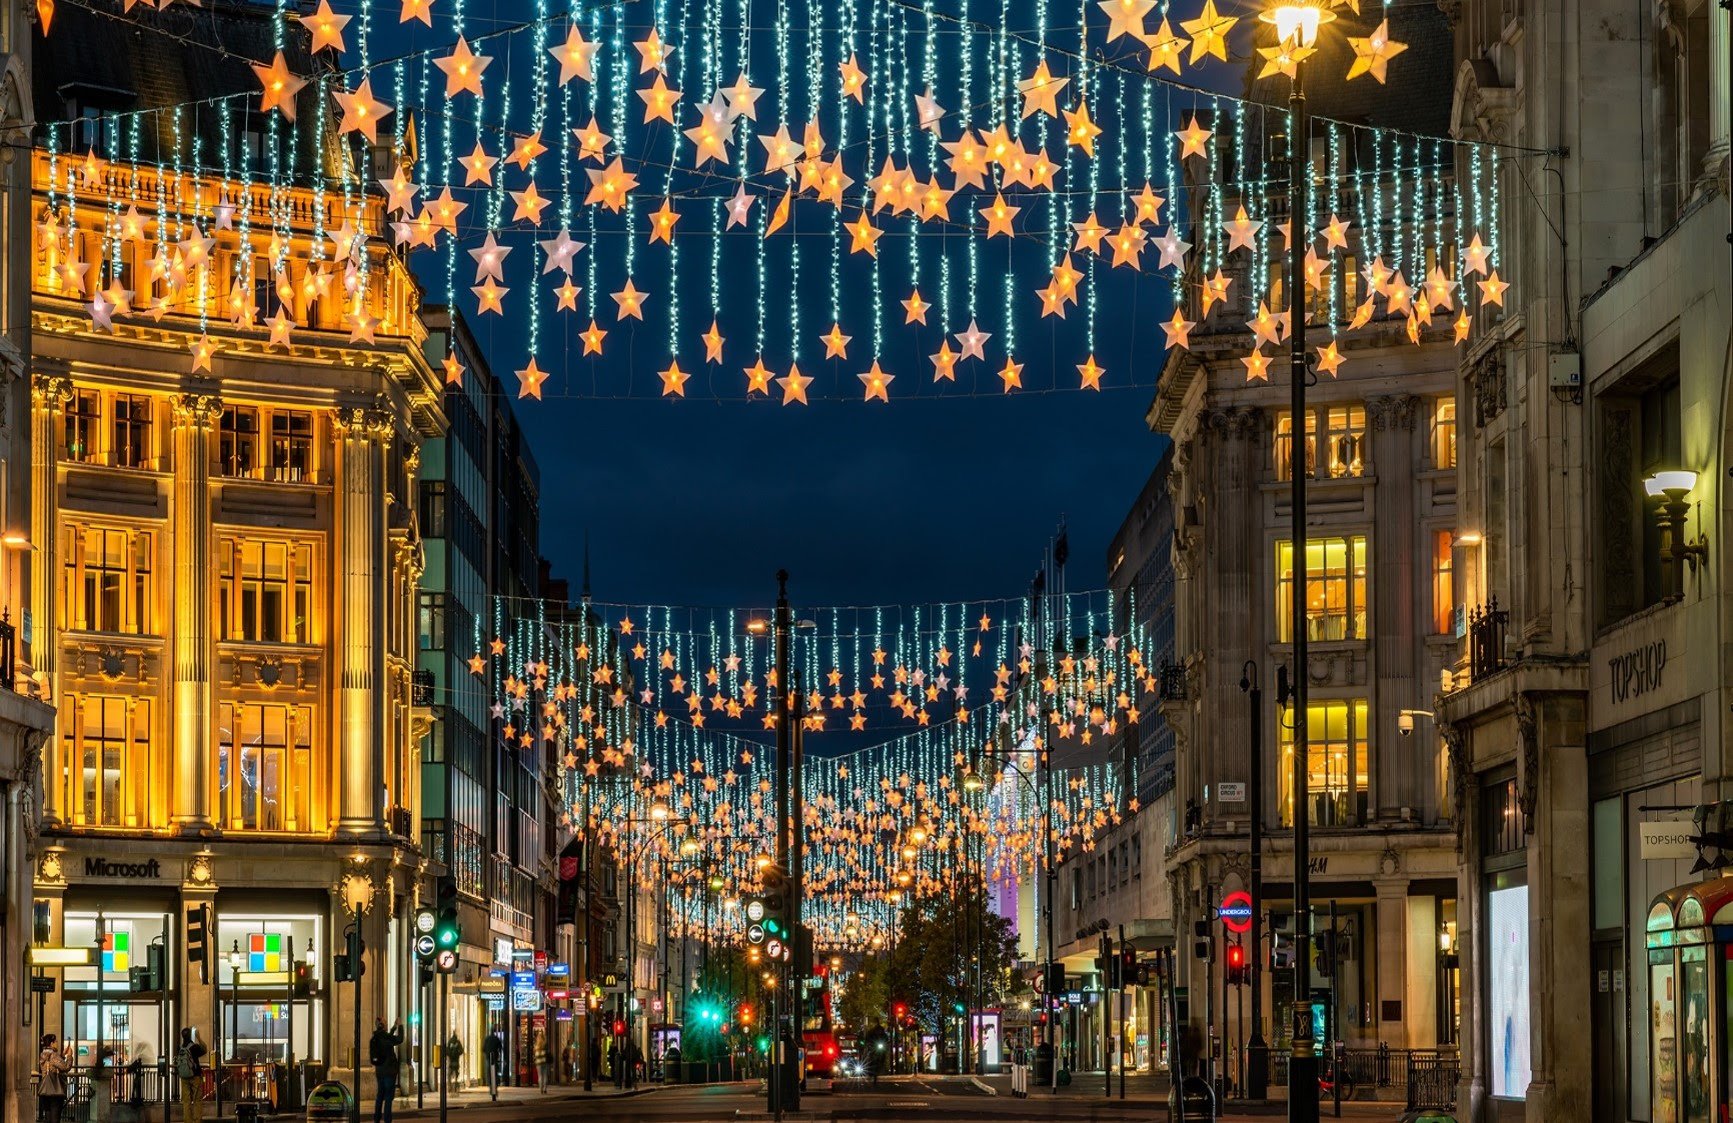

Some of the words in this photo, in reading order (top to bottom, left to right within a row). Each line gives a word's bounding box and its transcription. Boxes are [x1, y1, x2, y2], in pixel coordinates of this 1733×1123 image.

[1608, 638, 1667, 705] TOPSHOP
[1644, 835, 1691, 845] TOPSHOP
[85, 857, 160, 878] Microsoft
[516, 992, 537, 1001] Candy
